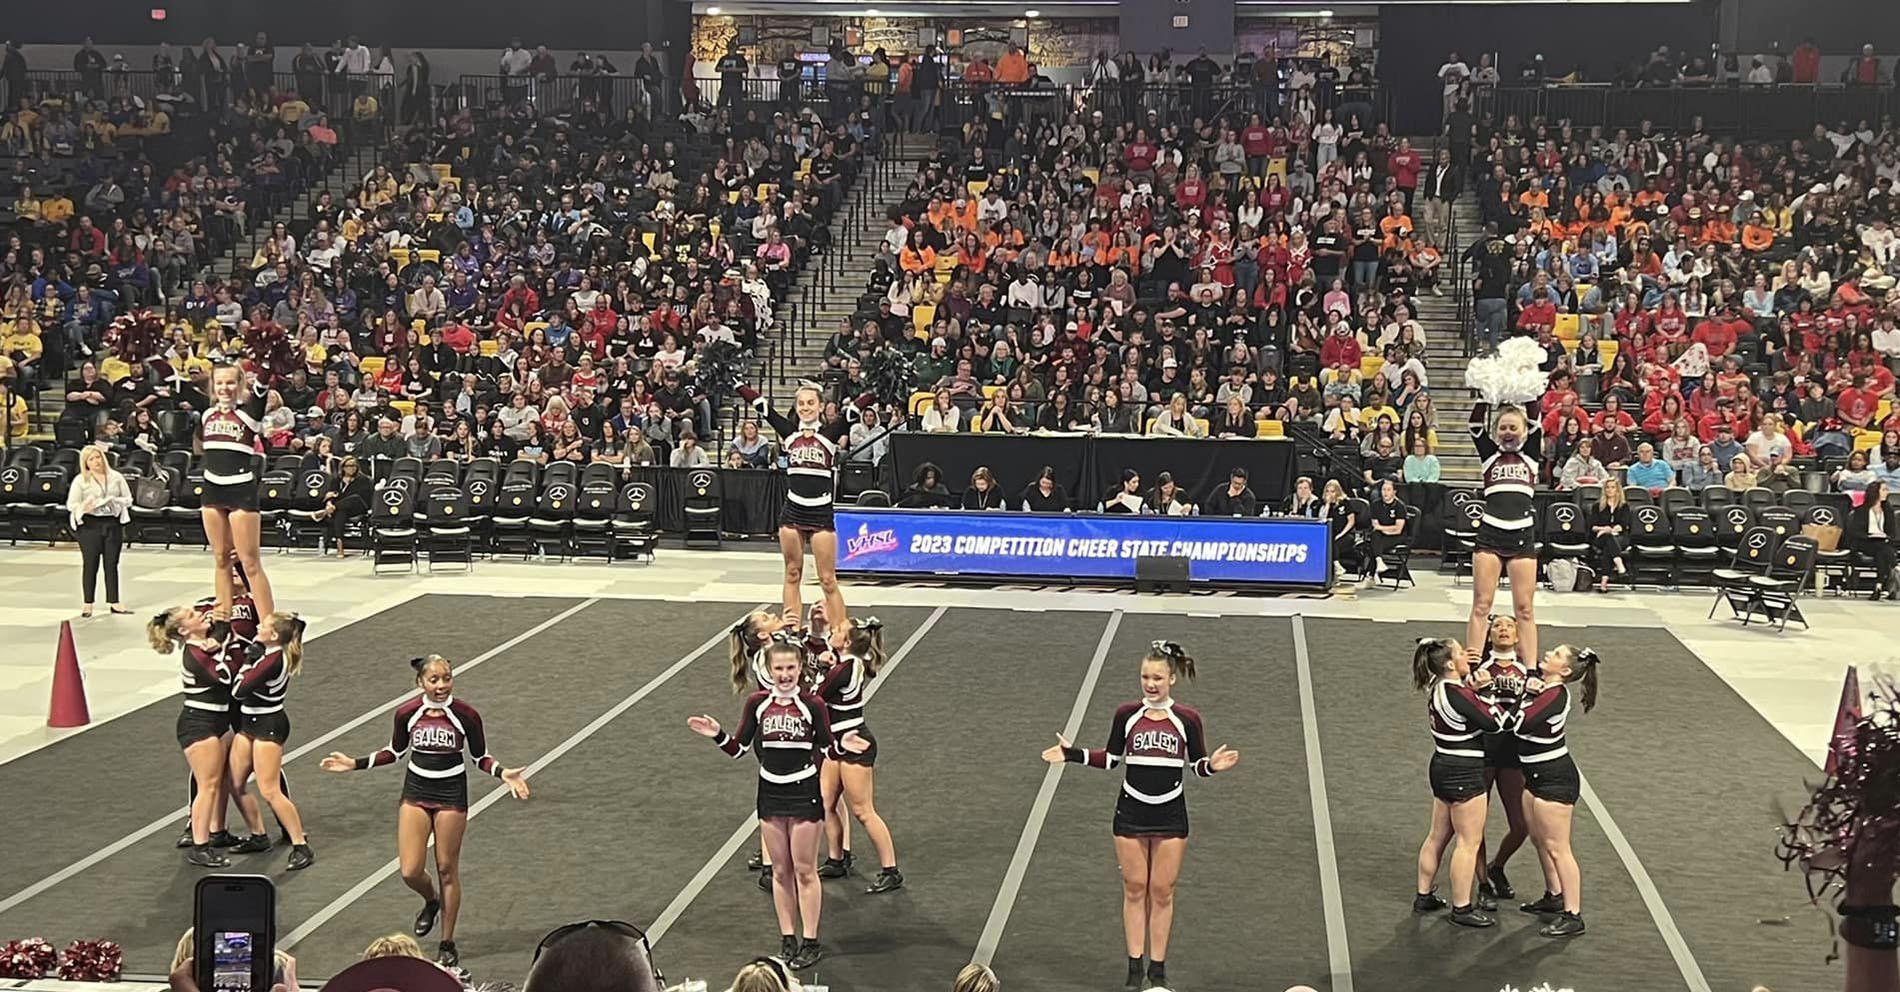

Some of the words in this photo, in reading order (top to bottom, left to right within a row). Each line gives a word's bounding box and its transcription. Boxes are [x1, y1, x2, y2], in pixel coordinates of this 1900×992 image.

[789, 445, 825, 468] SALEM
[1490, 463, 1528, 483] SALEM
[845, 529, 896, 553] VHSL
[908, 534, 950, 554] 2023
[955, 536, 1063, 557] COMPETITION
[1066, 538, 1117, 559] CHEER
[1120, 541, 1168, 559] STATE
[1171, 542, 1308, 564] CHAMPIONSHIPS
[412, 727, 456, 748] SALEM
[761, 716, 803, 736] SALEM
[1132, 731, 1178, 754] SALEM
